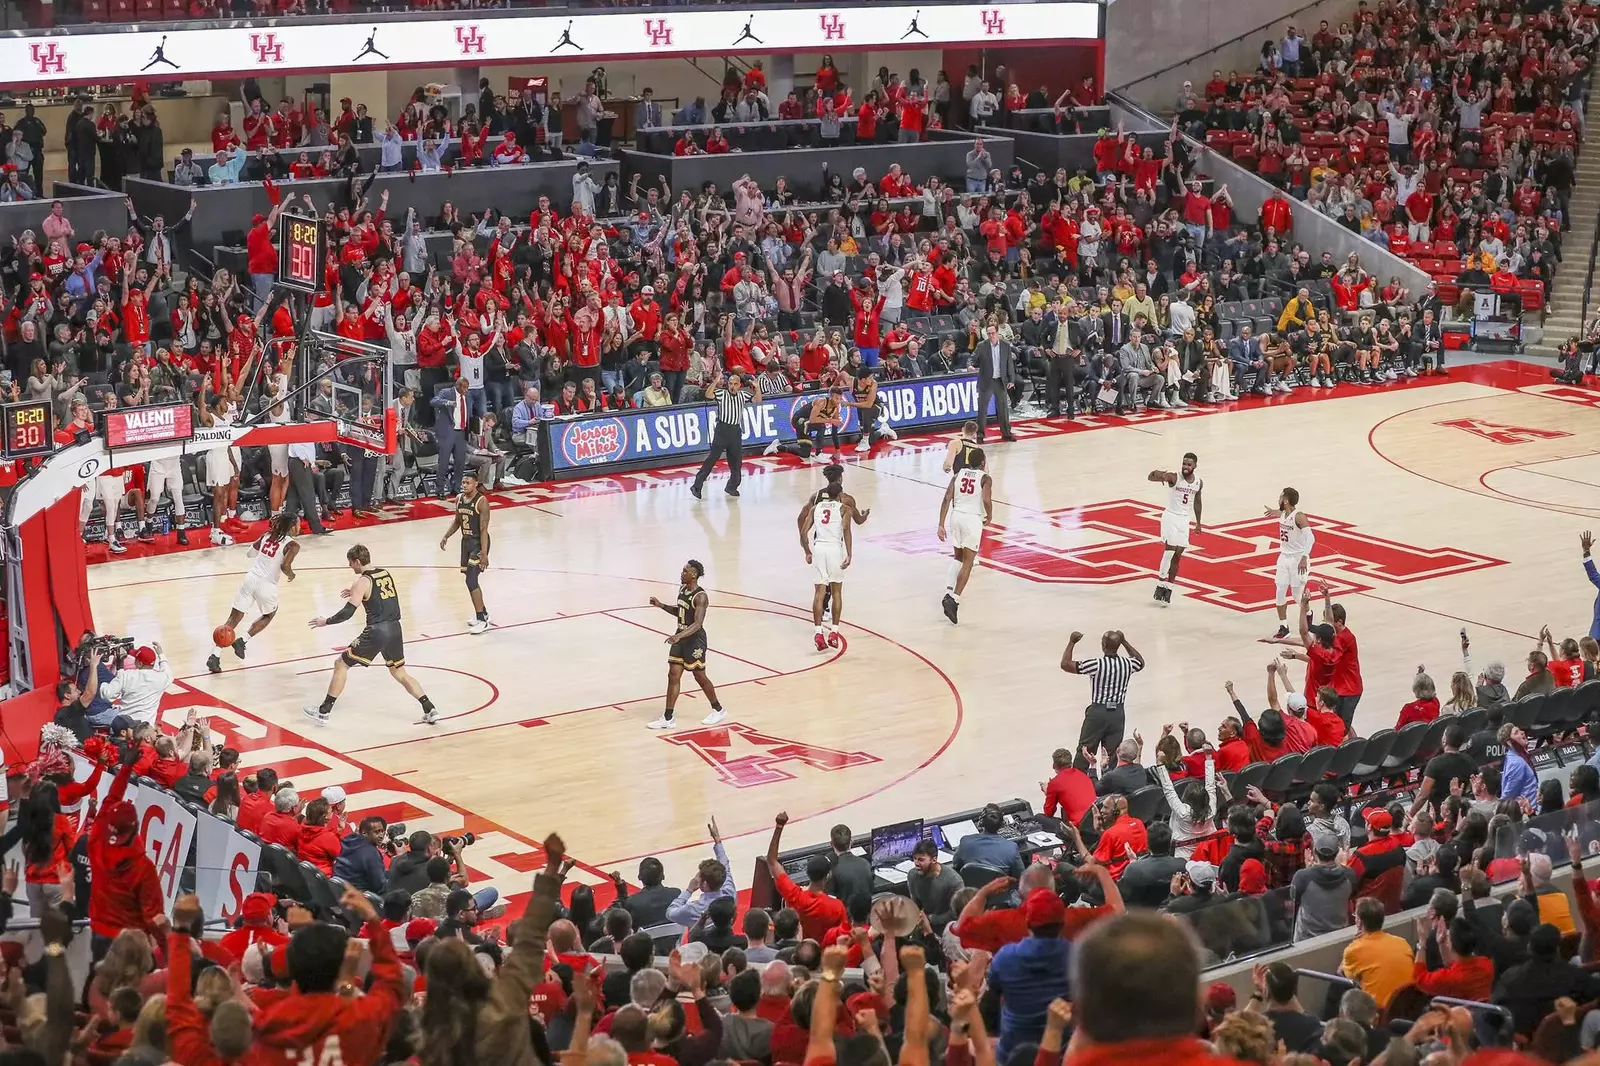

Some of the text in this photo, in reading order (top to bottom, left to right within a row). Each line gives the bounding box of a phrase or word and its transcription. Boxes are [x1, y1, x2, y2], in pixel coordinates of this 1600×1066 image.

[643, 18, 674, 47] UH
[818, 13, 846, 41] UH
[980, 8, 1006, 35] UH
[249, 33, 284, 64] UH
[454, 24, 486, 55] UH
[29, 42, 67, 75] UH
[293, 223, 316, 245] 8:20
[291, 244, 312, 279] 30
[16, 408, 44, 425] 8:20
[878, 387, 917, 424] SUB
[125, 408, 174, 429] VALENTI
[17, 426, 39, 447] 30
[570, 424, 618, 444] Jersey
[636, 418, 652, 453] A
[656, 412, 701, 450] SUB
[959, 477, 976, 495] 35
[1182, 494, 1189, 504] 5
[462, 514, 470, 530] 2
[821, 509, 832, 525] 3
[260, 538, 280, 558] 23
[375, 576, 395, 600] 33
